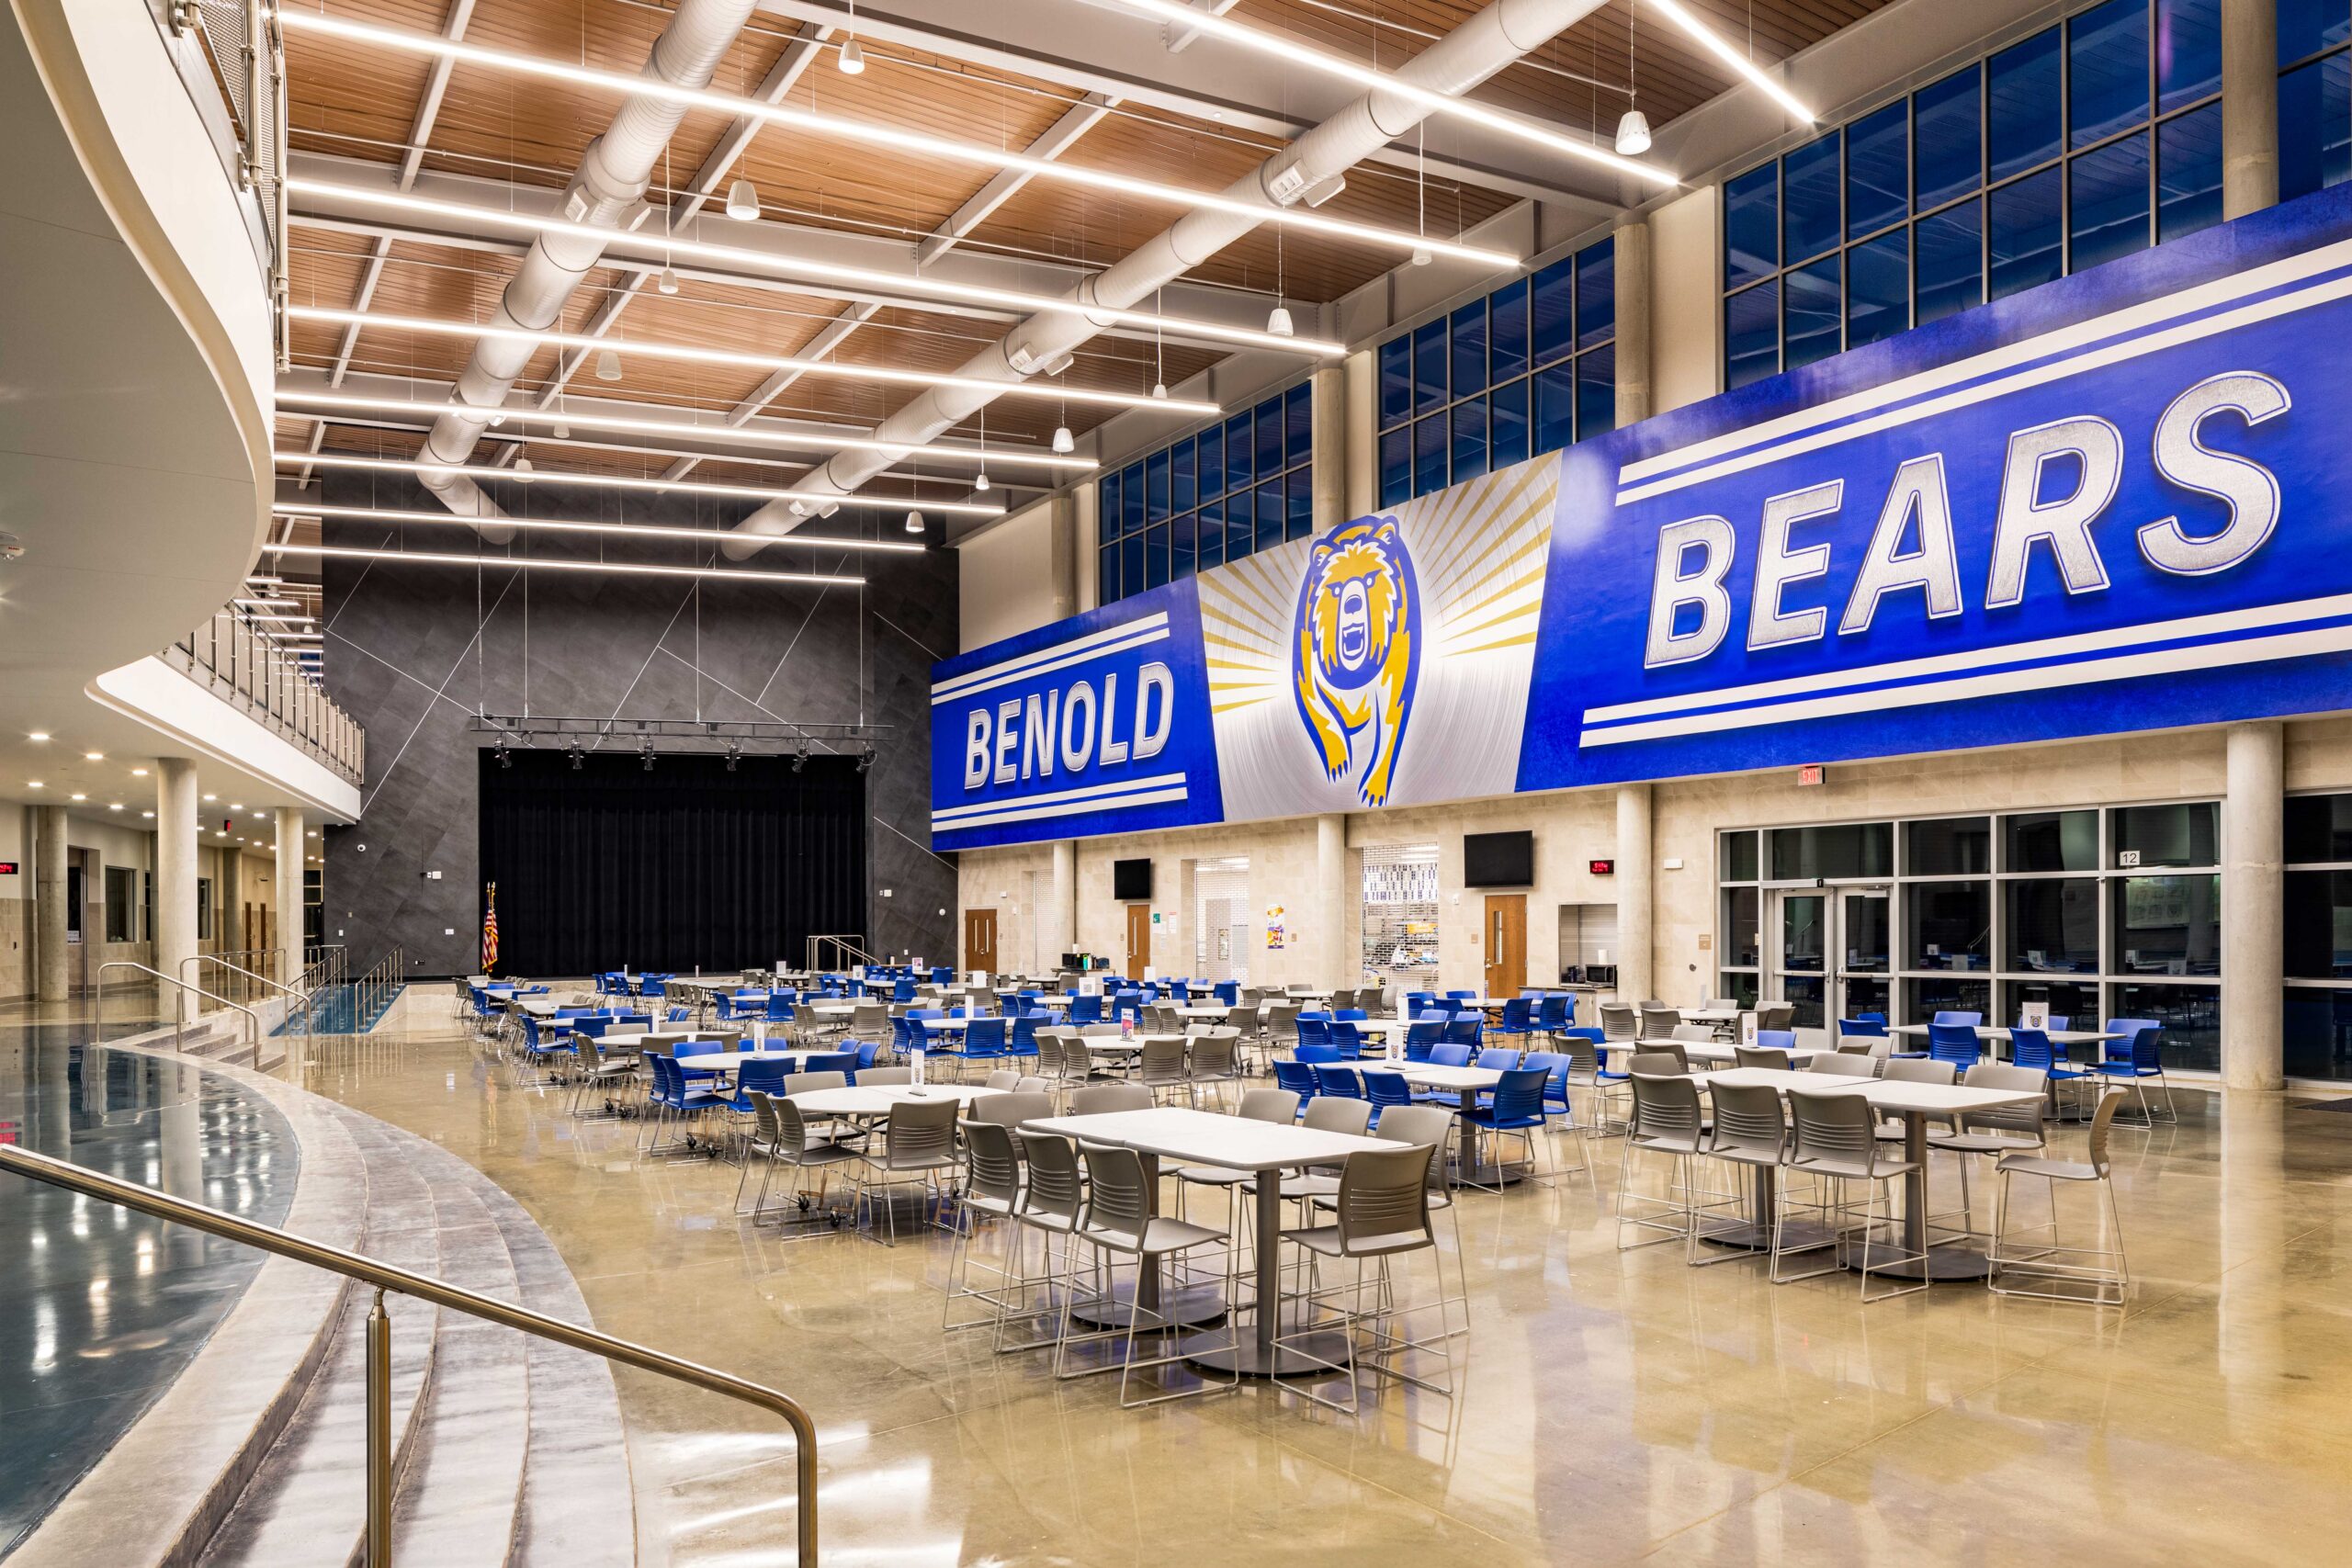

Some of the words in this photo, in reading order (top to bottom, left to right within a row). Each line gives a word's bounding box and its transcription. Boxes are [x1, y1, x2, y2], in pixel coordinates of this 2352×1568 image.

[1644, 369, 2291, 670] BEARS
[965, 661, 1174, 790] BENOLD
[1803, 769, 1818, 784] EXIT
[2122, 852, 2137, 863] 12
